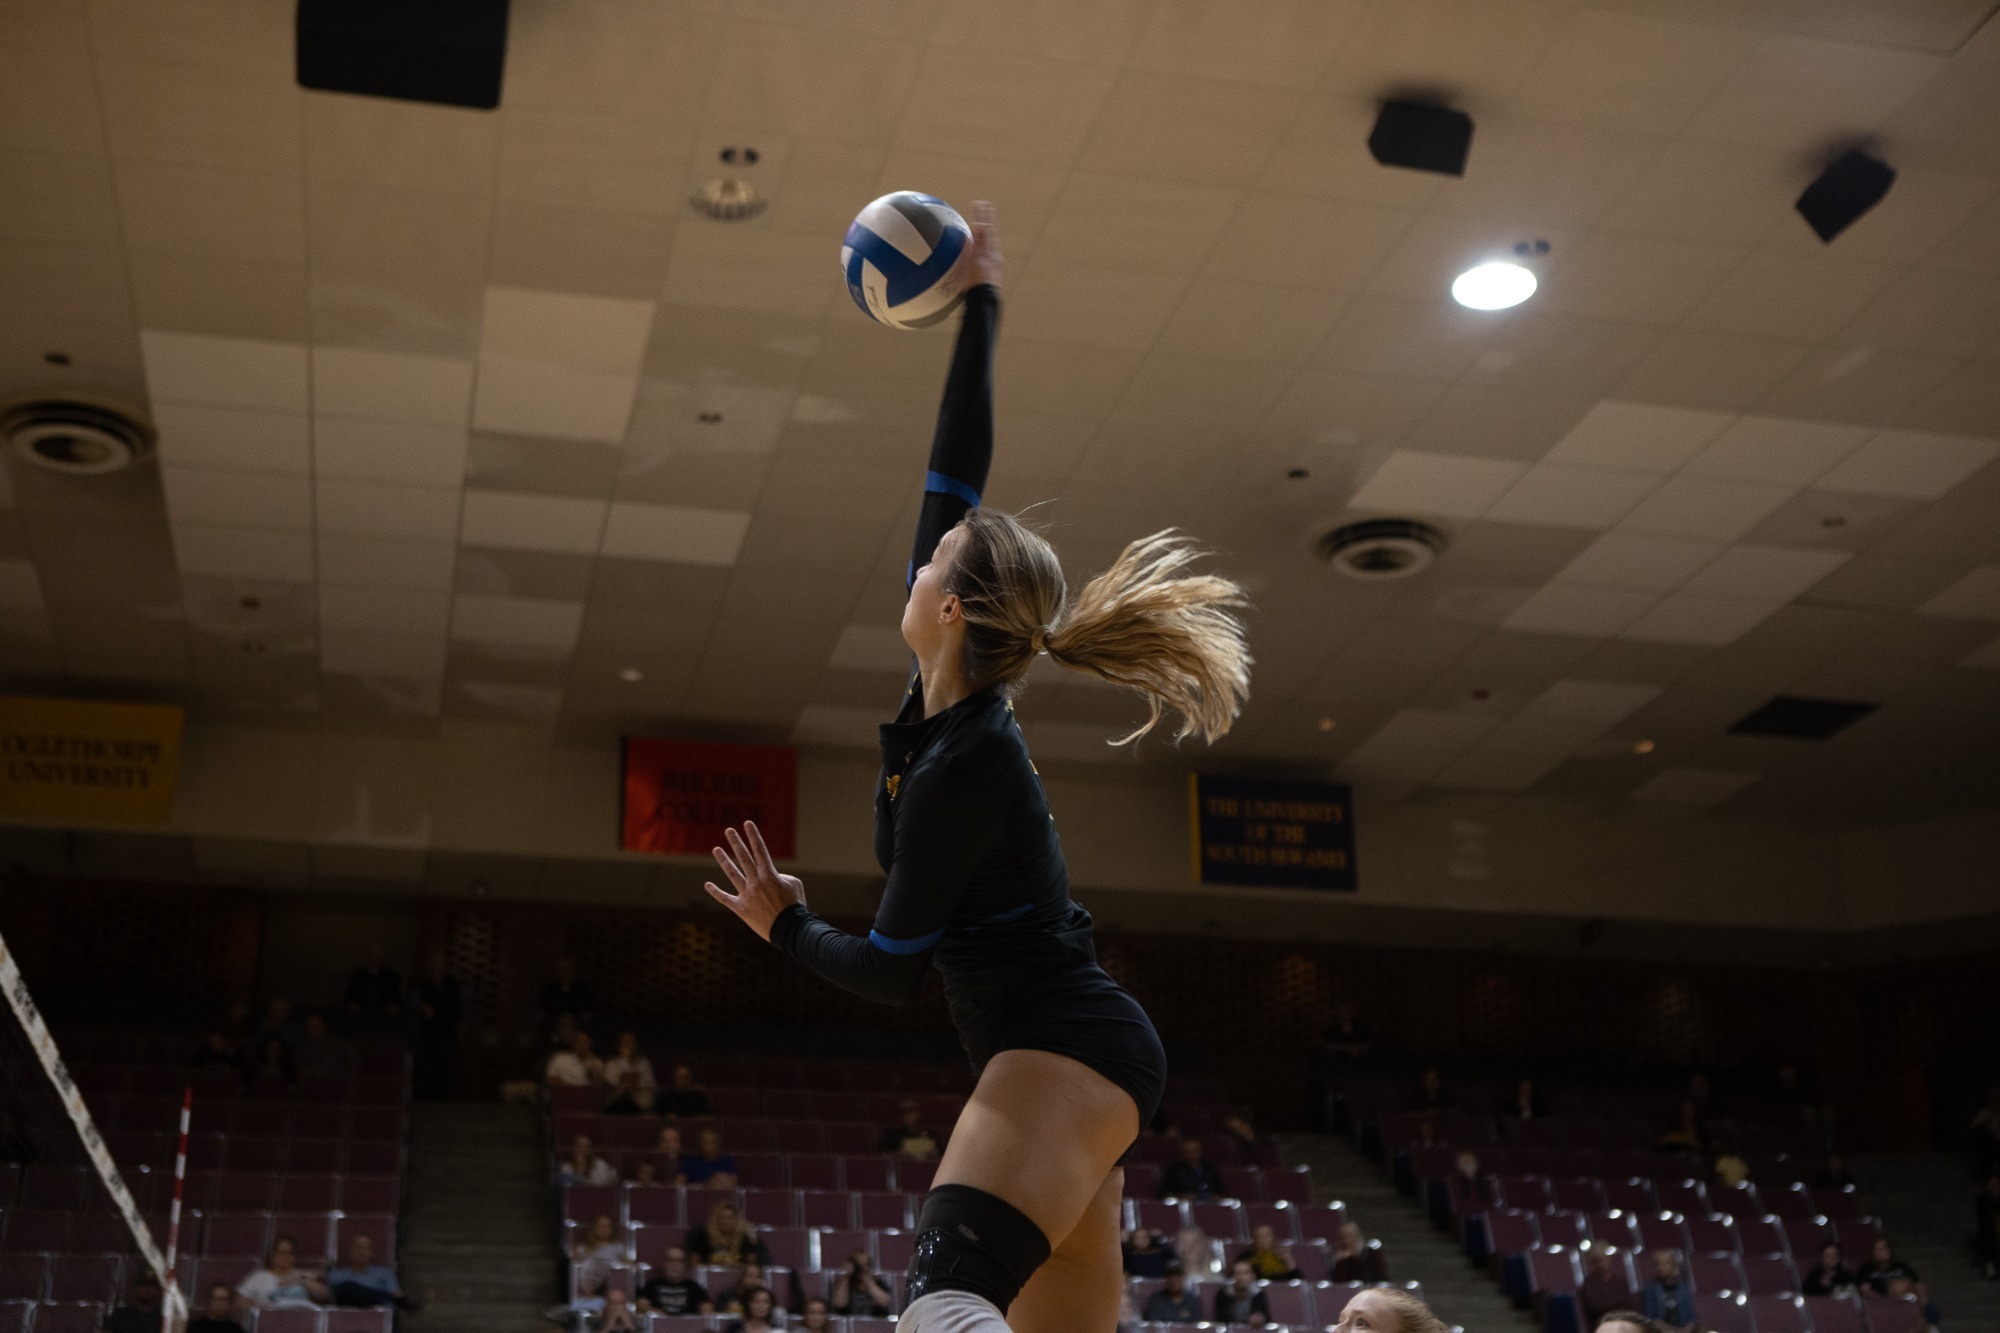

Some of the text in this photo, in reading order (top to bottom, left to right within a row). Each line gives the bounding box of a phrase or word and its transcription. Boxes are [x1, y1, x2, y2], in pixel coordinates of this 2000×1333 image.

[8, 759, 151, 790] UNIVERSITY
[1206, 796, 1343, 823] THE UNIVERSITY
[1245, 823, 1305, 845] OF THE
